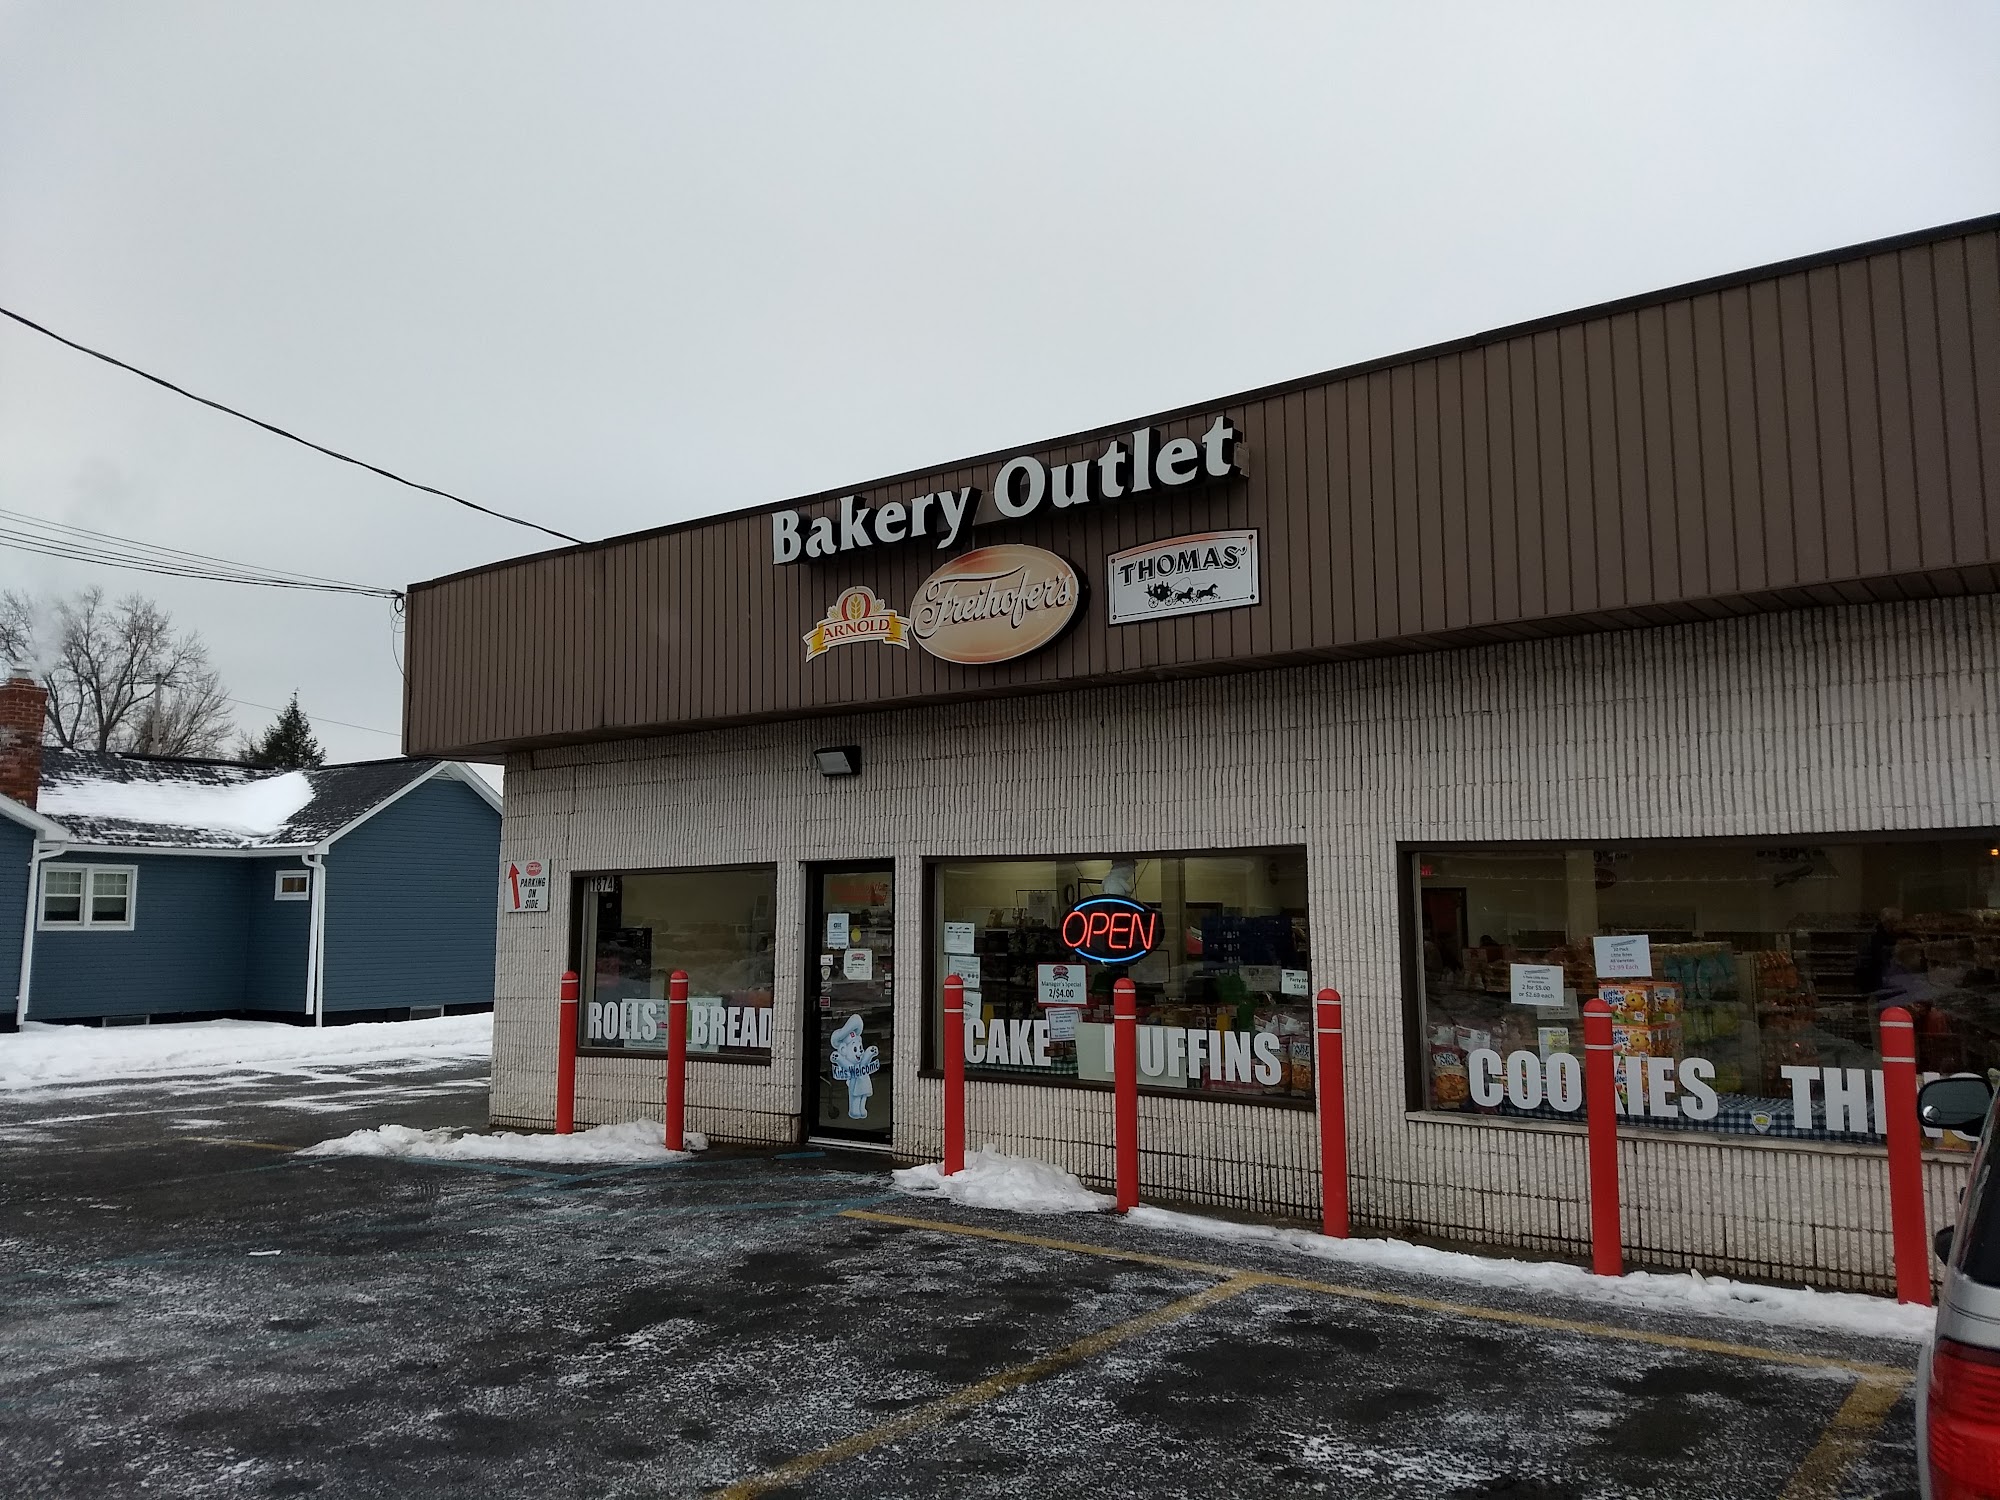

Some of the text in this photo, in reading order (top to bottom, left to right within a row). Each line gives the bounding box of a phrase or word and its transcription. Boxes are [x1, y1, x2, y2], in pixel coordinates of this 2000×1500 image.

[772, 416, 1236, 566] Bakery Outlet
[914, 565, 1073, 639] Freihofer's
[823, 619, 890, 640] ARNOLD
[520, 877, 546, 887] PARKING
[591, 876, 614, 892] 1874
[528, 889, 537, 898] ON
[525, 899, 539, 909] SIDE
[1062, 910, 1156, 950] OPEN
[1048, 988, 1075, 999] 2/$4.00
[587, 1001, 773, 1048] ROLLS BREAD
[964, 1018, 1052, 1067] CAKE
[833, 1062, 879, 1078] Kids Welcome
